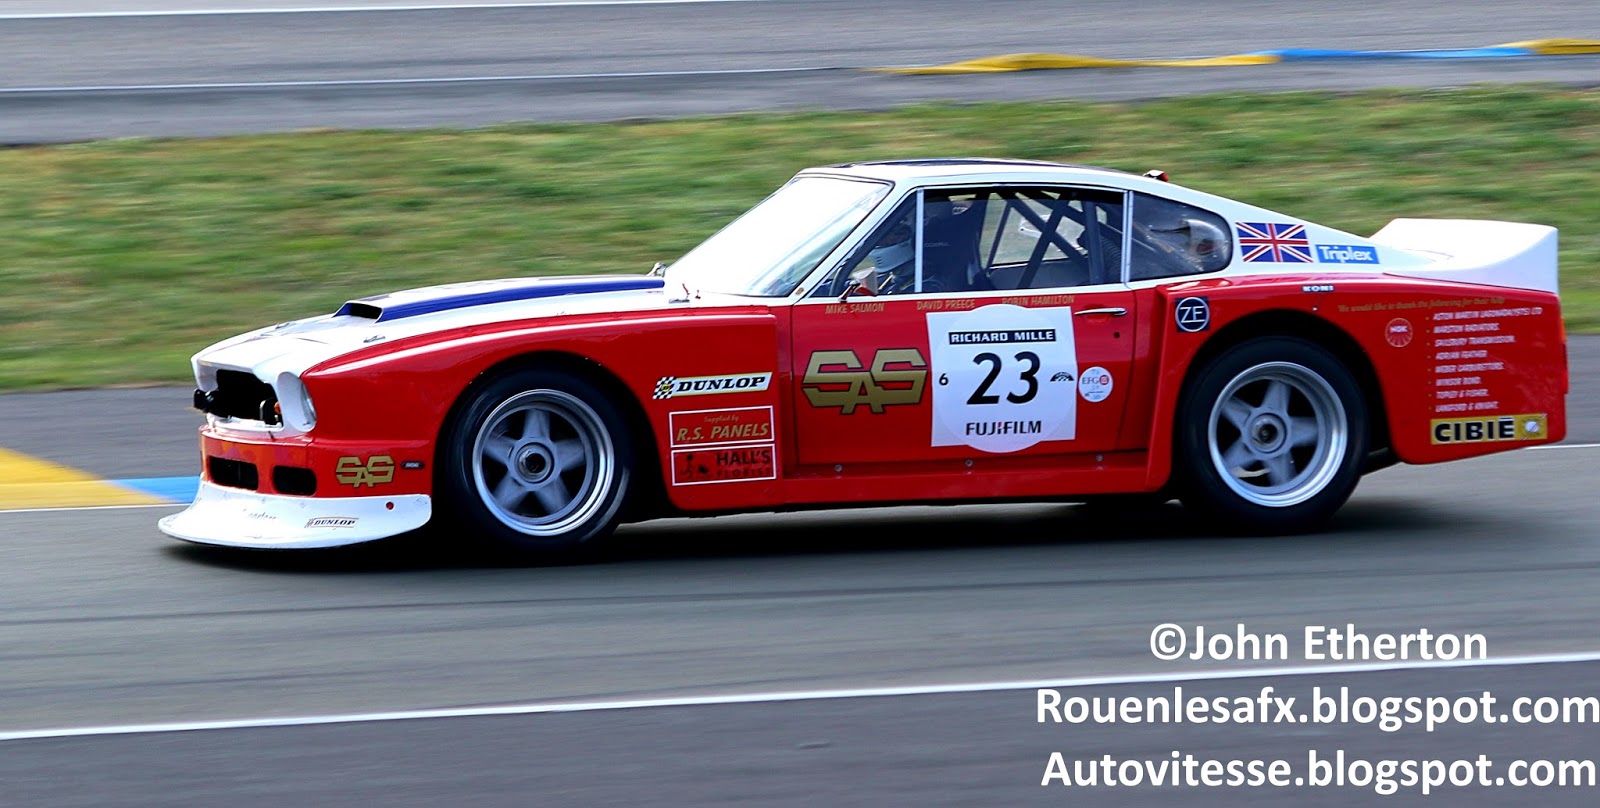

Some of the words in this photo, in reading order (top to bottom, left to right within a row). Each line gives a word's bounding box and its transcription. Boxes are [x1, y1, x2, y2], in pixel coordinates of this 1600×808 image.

[1318, 246, 1374, 263] Triplex
[916, 300, 943, 311] DAVID
[945, 299, 976, 310] PREECE
[1031, 295, 1075, 306] HAMILTON
[825, 304, 848, 314] MIKE
[850, 303, 885, 313] SALMON
[1180, 306, 1206, 323] ZF
[951, 332, 1008, 343] RICHARD
[1014, 330, 1054, 341] MILLE
[677, 376, 766, 392] DUNLOP
[939, 373, 949, 386] 6
[966, 351, 1040, 405] 23
[1082, 376, 1099, 385] EFG
[704, 414, 731, 424] Supplied
[731, 414, 740, 423] by
[676, 427, 705, 441] R.S.
[710, 423, 769, 439] PANELS
[965, 420, 1042, 436] FUJIFILM
[716, 450, 770, 465] HALL'S
[314, 519, 356, 527] DUNLOP
